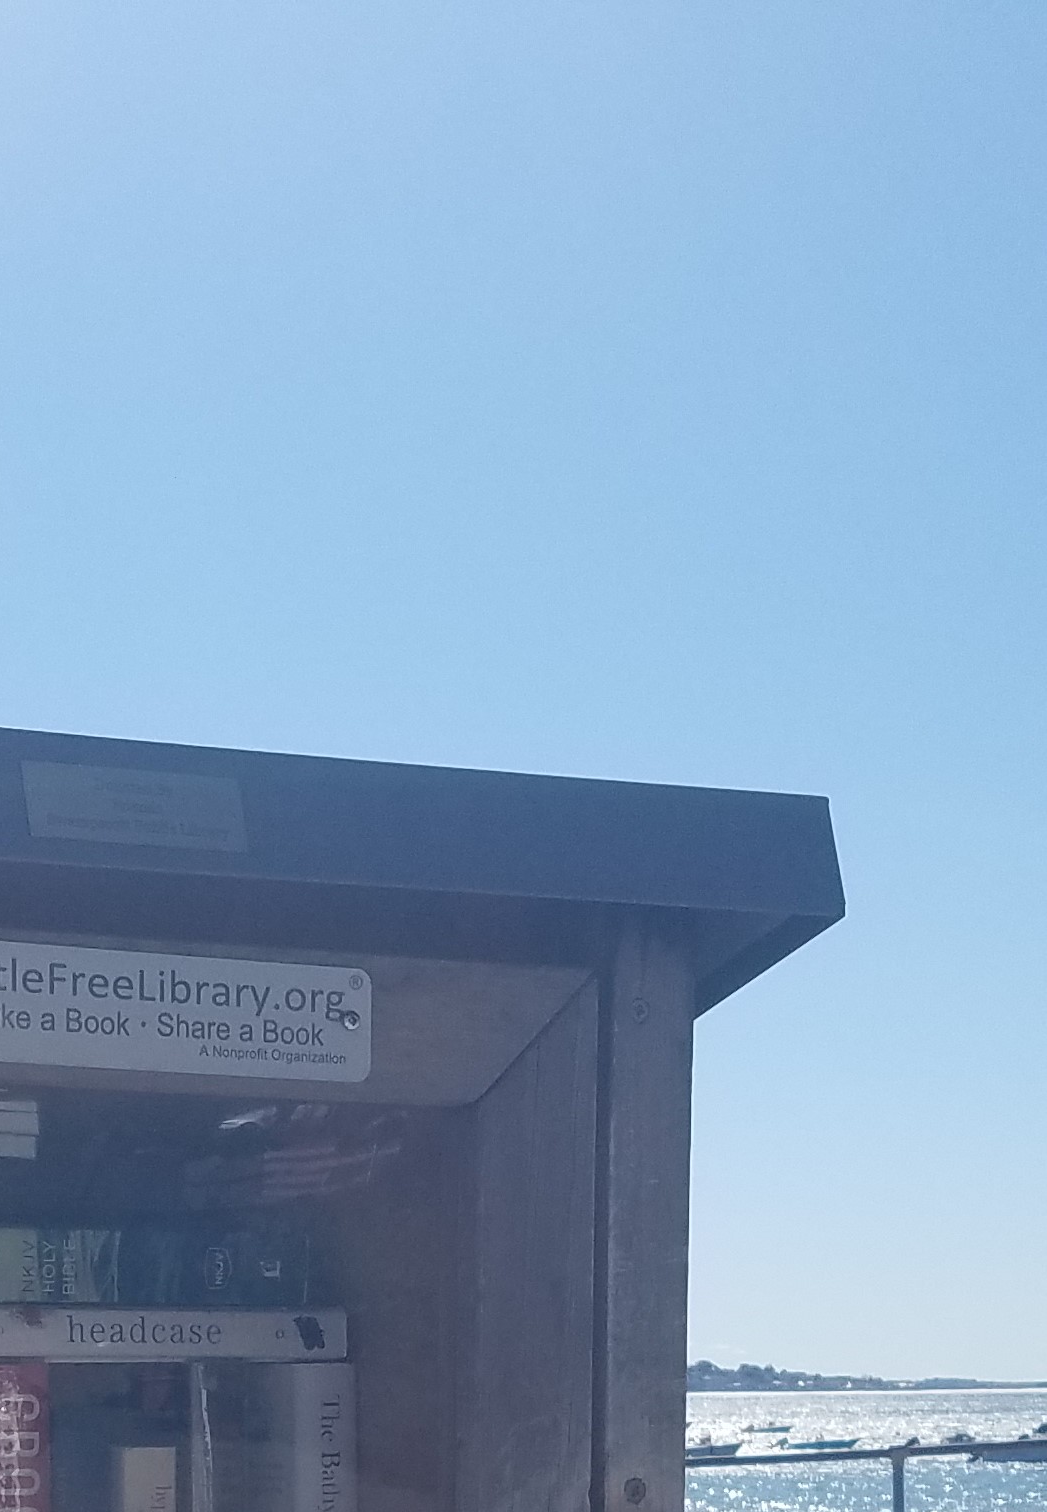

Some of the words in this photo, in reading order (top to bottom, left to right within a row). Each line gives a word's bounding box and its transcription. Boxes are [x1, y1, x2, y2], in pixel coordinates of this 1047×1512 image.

[40, 1013, 56, 1032] a
[65, 1007, 131, 1038] Book
[156, 1012, 232, 1043] Share
[239, 1025, 255, 1043] a
[262, 1018, 324, 1048] Book
[198, 1045, 210, 1058] A
[211, 1045, 268, 1065] Nonprofit
[270, 1047, 347, 1066] Organization
[22, 1239, 36, 1294] NKJV
[41, 1240, 56, 1296] HOLY
[61, 1238, 76, 1296] BIBLE
[214, 1253, 225, 1287] NKJV
[67, 1314, 223, 1345] headcase
[320, 1394, 342, 1442] The
